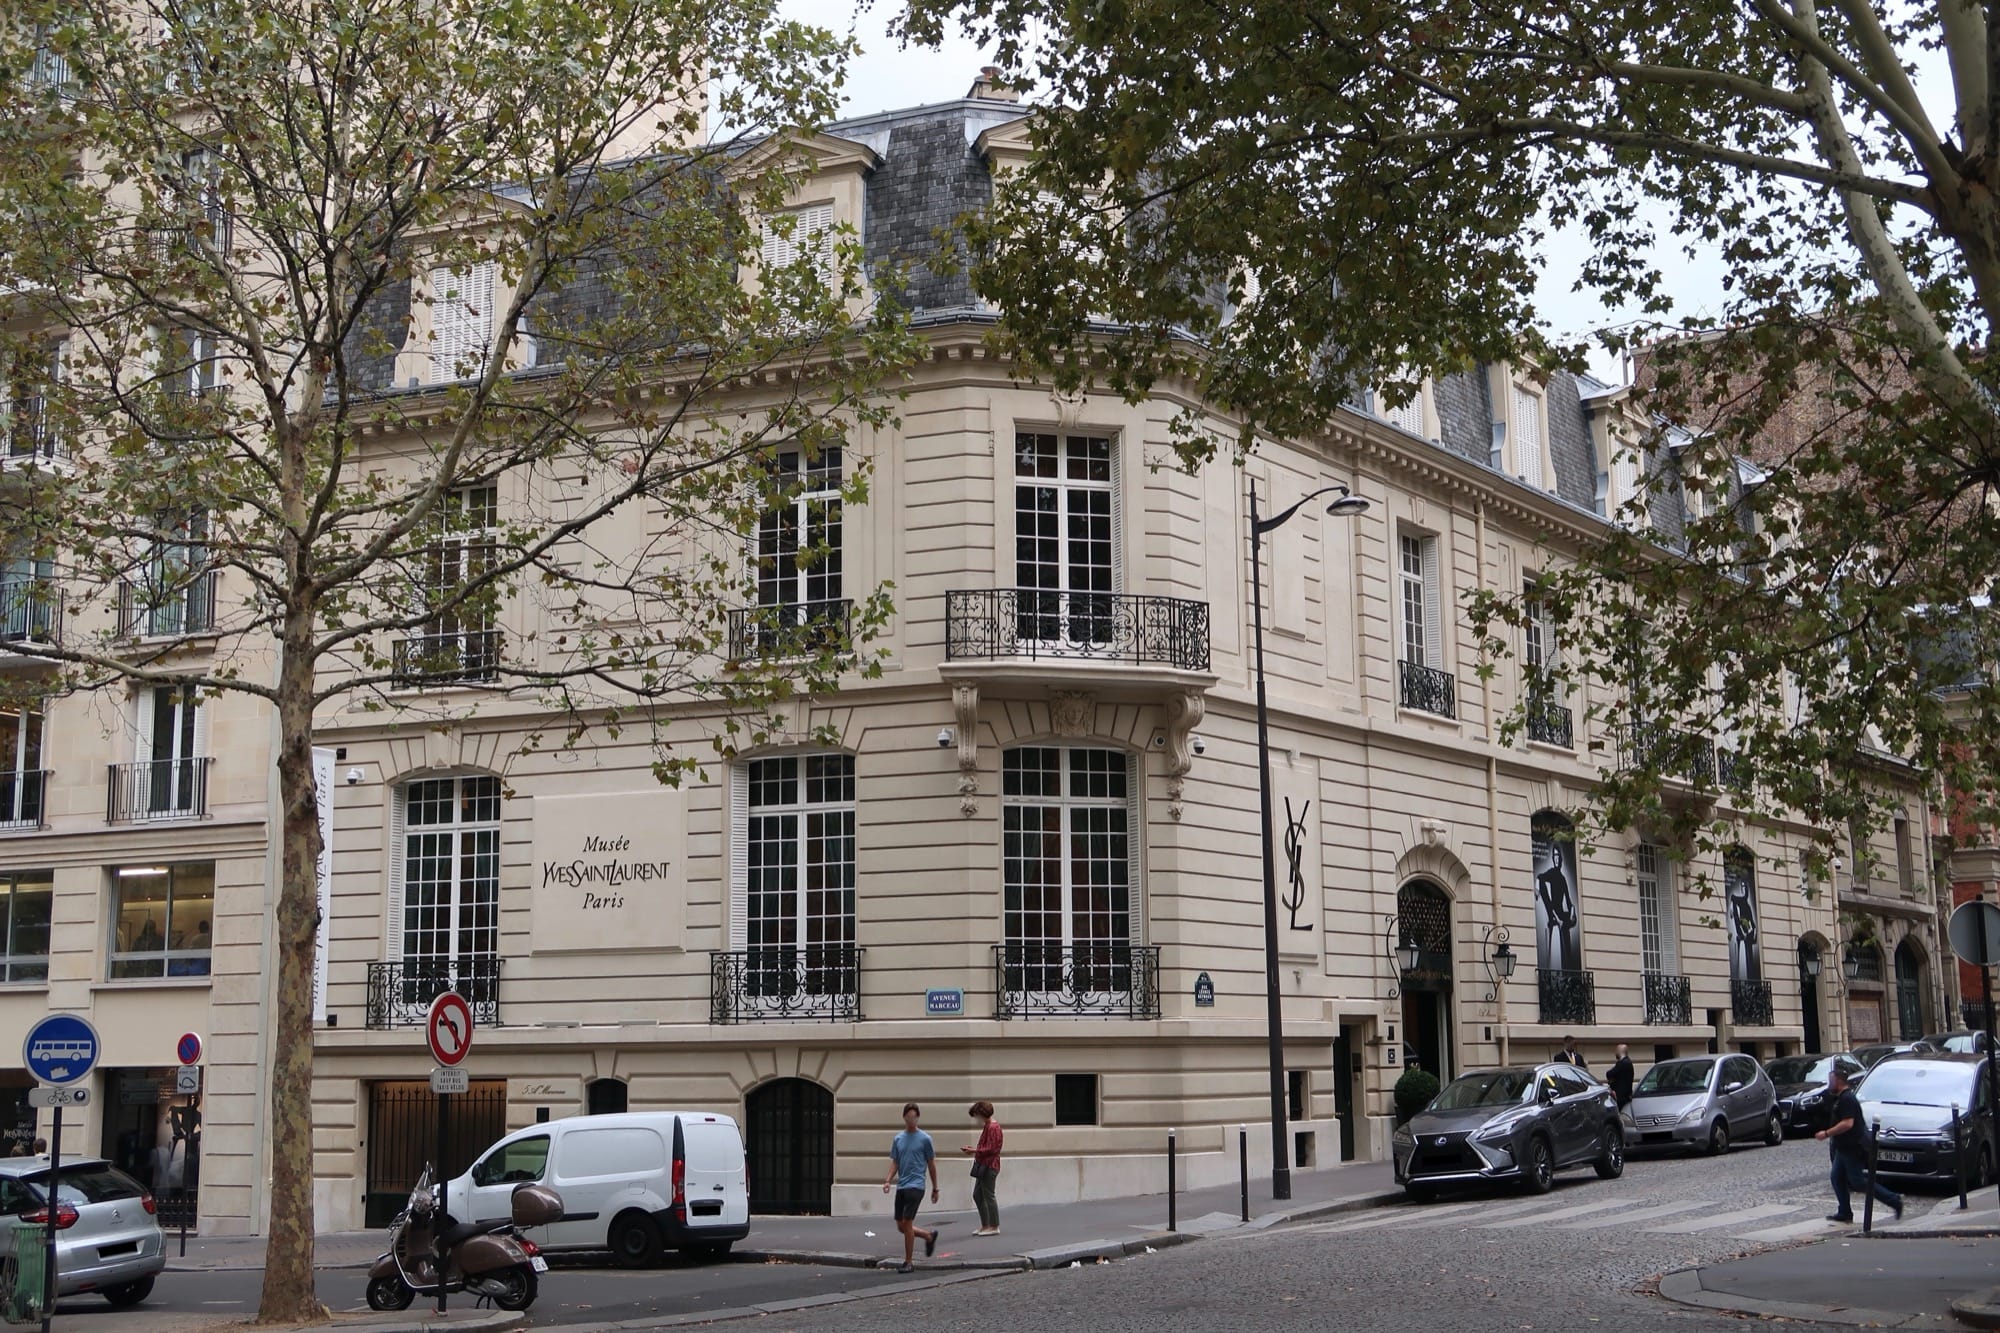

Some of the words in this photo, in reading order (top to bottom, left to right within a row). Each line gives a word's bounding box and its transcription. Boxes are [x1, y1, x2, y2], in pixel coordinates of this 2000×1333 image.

[317, 766, 327, 808] Paris
[582, 834, 630, 853] Musée
[1281, 796, 1314, 931] YSL
[582, 892, 625, 910] Paris
